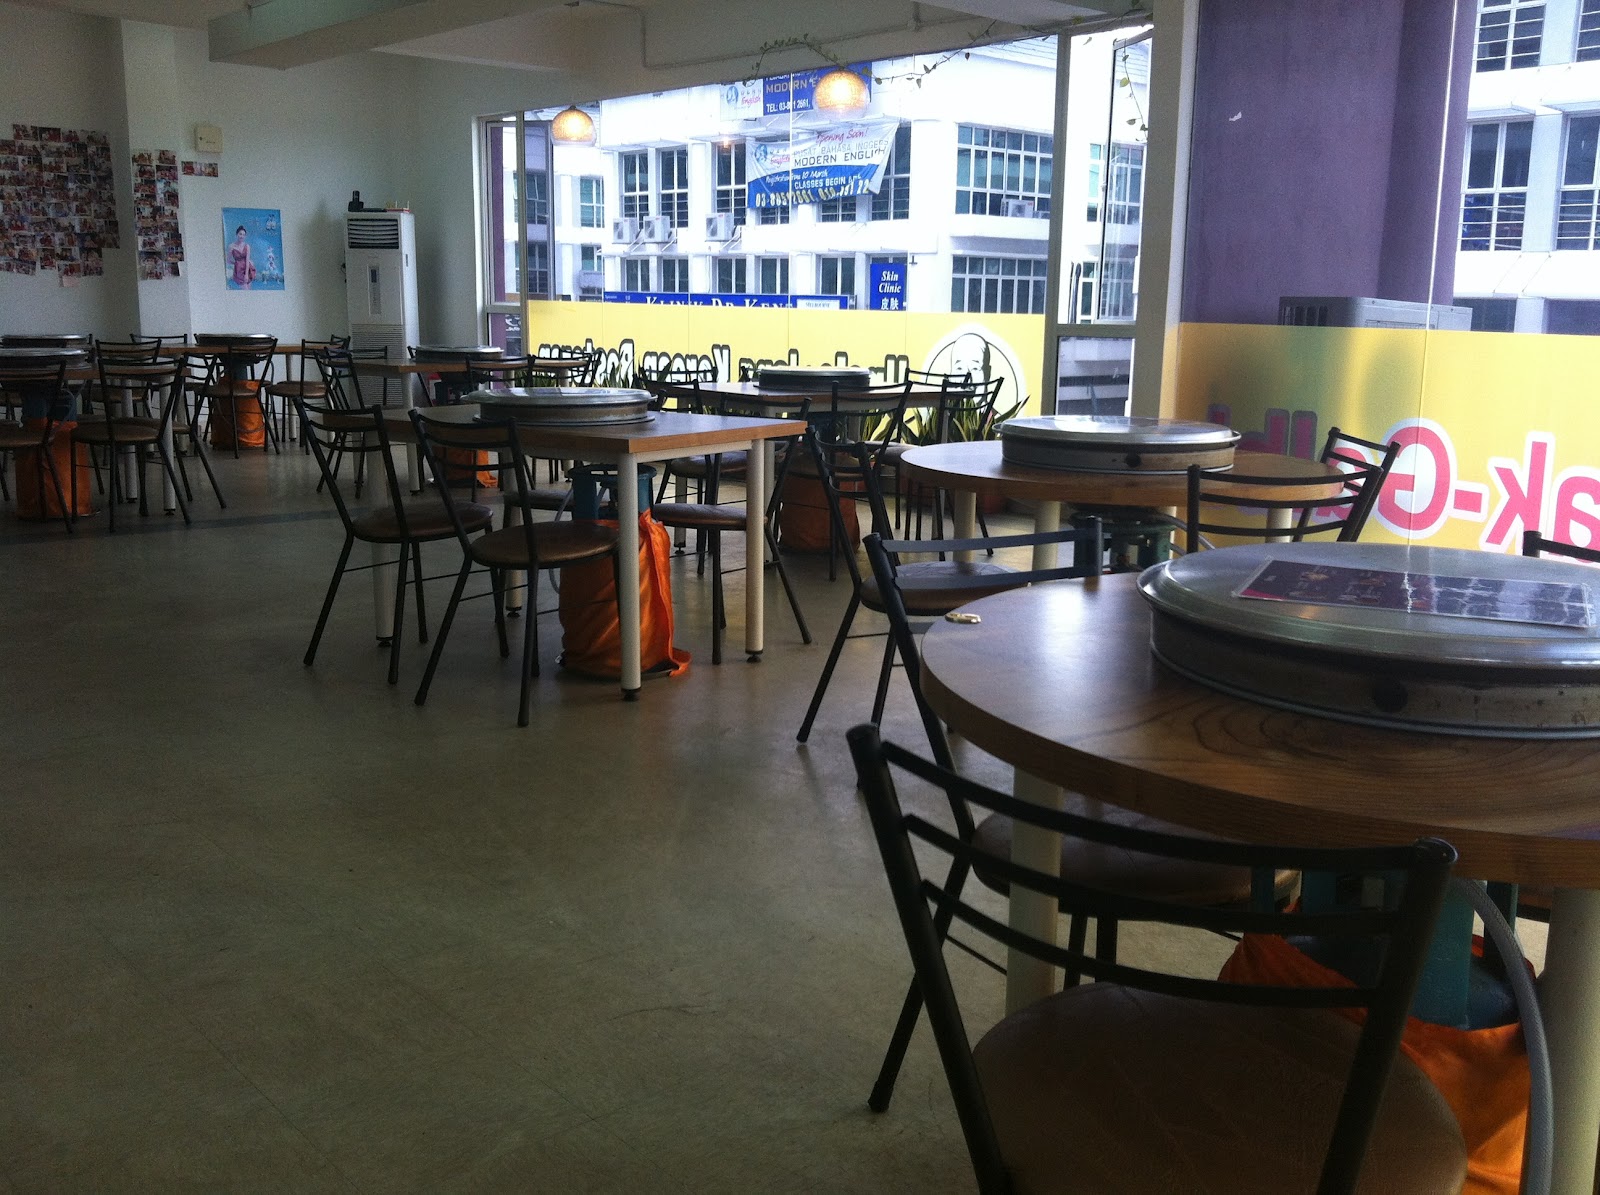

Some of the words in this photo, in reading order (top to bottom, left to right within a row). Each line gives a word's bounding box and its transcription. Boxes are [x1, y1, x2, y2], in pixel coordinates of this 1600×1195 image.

[766, 103, 778, 113] TEL:
[779, 101, 796, 111] 03-81
[821, 143, 852, 154] BAHASA
[794, 154, 837, 168] MODERN
[844, 146, 887, 162] ENGLIH
[794, 179, 824, 190] CLASSES
[826, 176, 846, 187] BEGIN
[881, 271, 899, 282] Skin
[878, 282, 902, 293] Clinic
